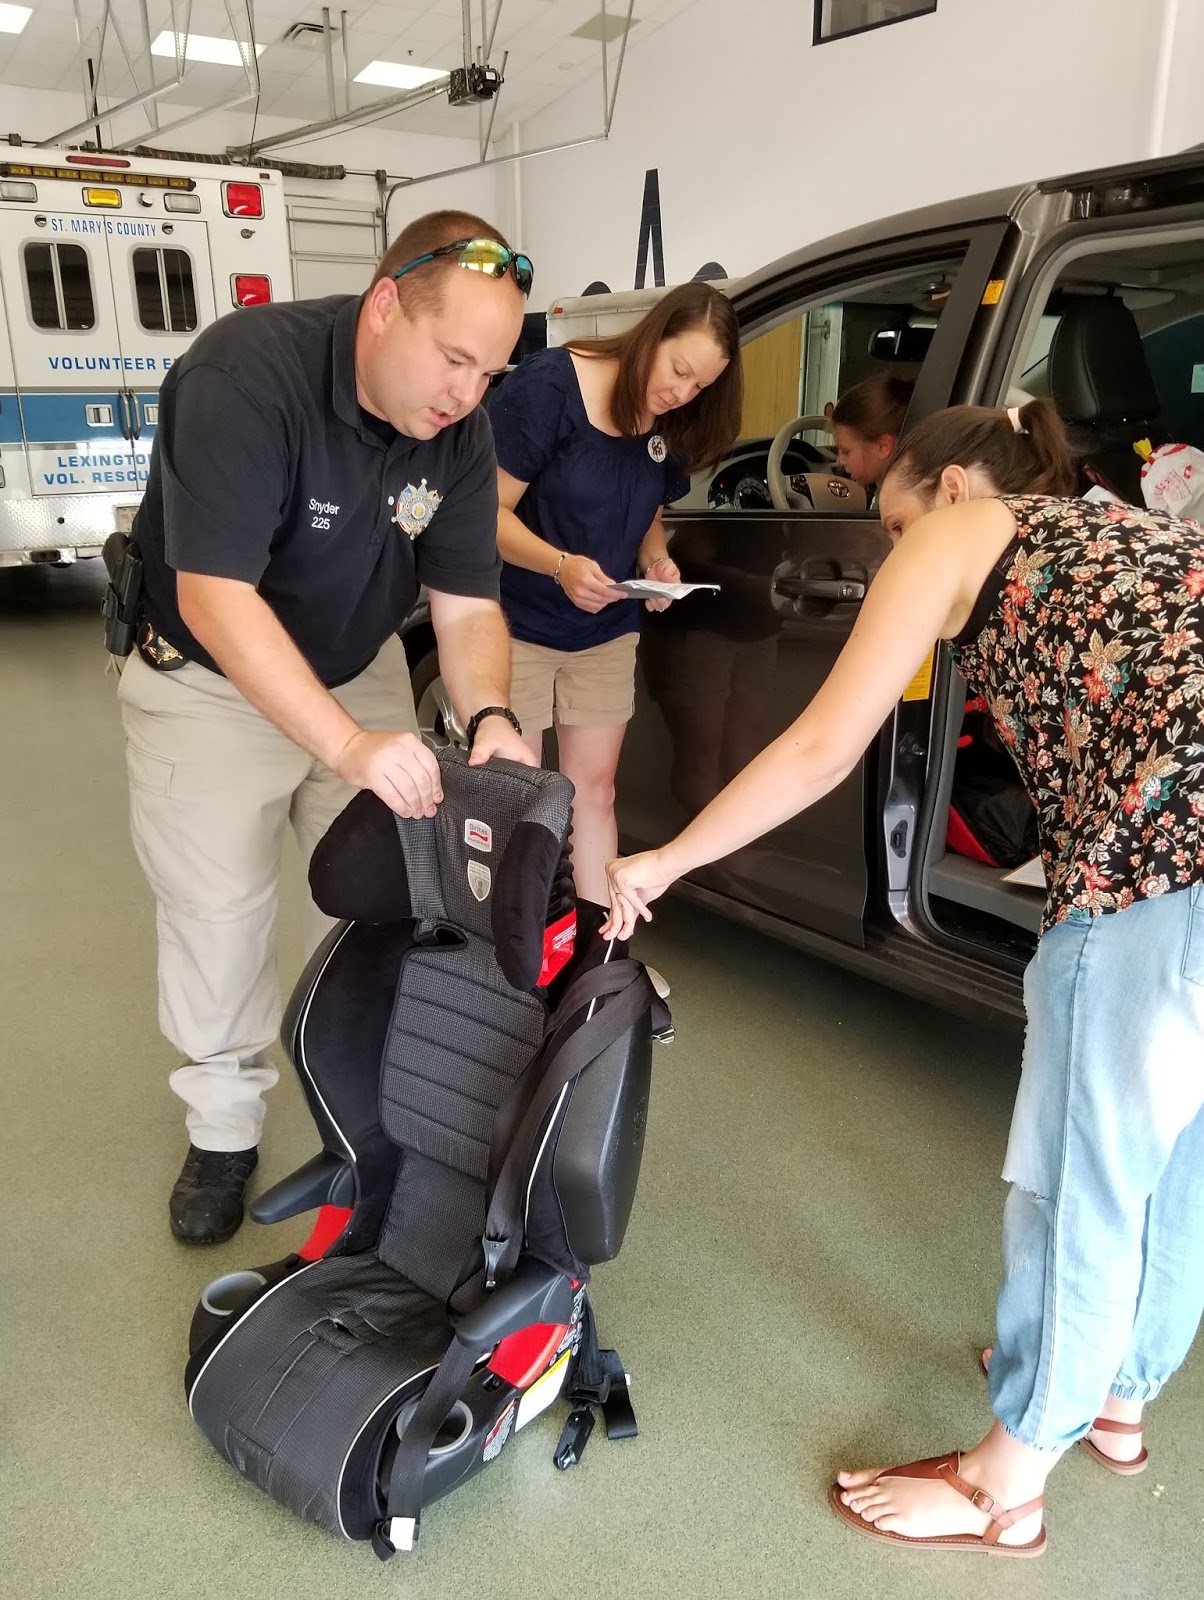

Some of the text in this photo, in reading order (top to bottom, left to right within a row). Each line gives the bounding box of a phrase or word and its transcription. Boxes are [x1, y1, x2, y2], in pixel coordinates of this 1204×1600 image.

[51, 218, 67, 232] ST.
[116, 222, 156, 236] COUNTY
[48, 356, 156, 370] VOLUNTEER
[43, 470, 149, 485] VOL. RESCU
[308, 498, 340, 515] Snyder
[311, 516, 330, 530] 225
